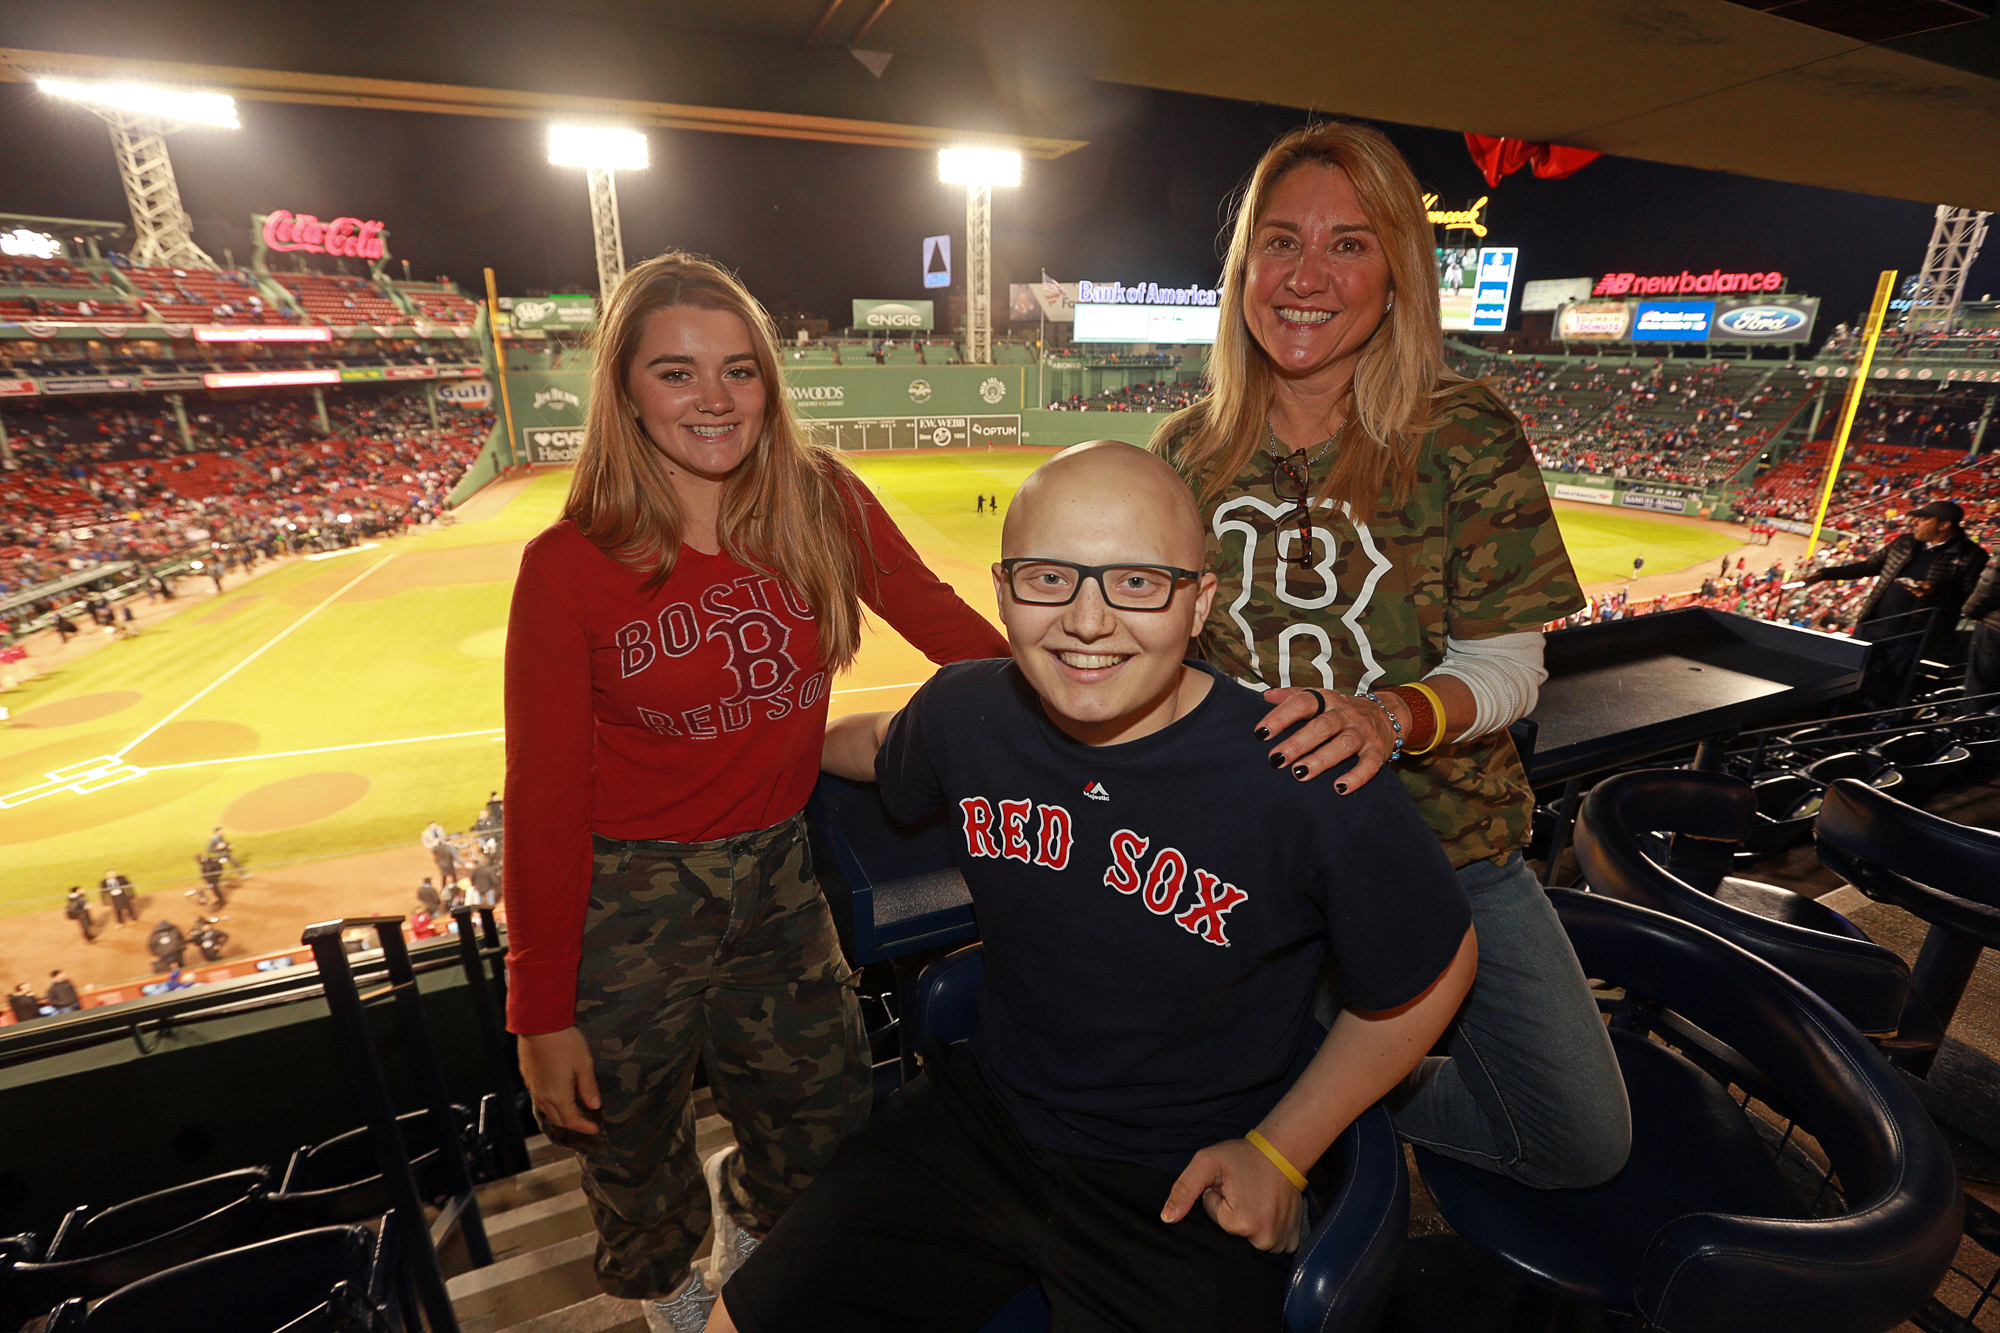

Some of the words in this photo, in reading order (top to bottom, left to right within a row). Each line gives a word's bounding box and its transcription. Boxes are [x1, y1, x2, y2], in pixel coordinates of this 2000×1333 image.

[262, 209, 386, 260] Coca-Cola
[1079, 281, 1126, 303] Bank
[1126, 282, 1147, 303] of
[1145, 283, 1217, 306] America
[1733, 310, 1790, 331] Ford
[439, 384, 486, 399] Gulf
[937, 418, 966, 427] WEBB
[982, 426, 1017, 436] OPTUM
[551, 431, 586, 447] CVS
[615, 574, 815, 679] BOSTO
[637, 702, 751, 736] RED
[766, 671, 831, 720] SO
[959, 796, 1075, 871] RED
[1103, 829, 1249, 946] SOX
